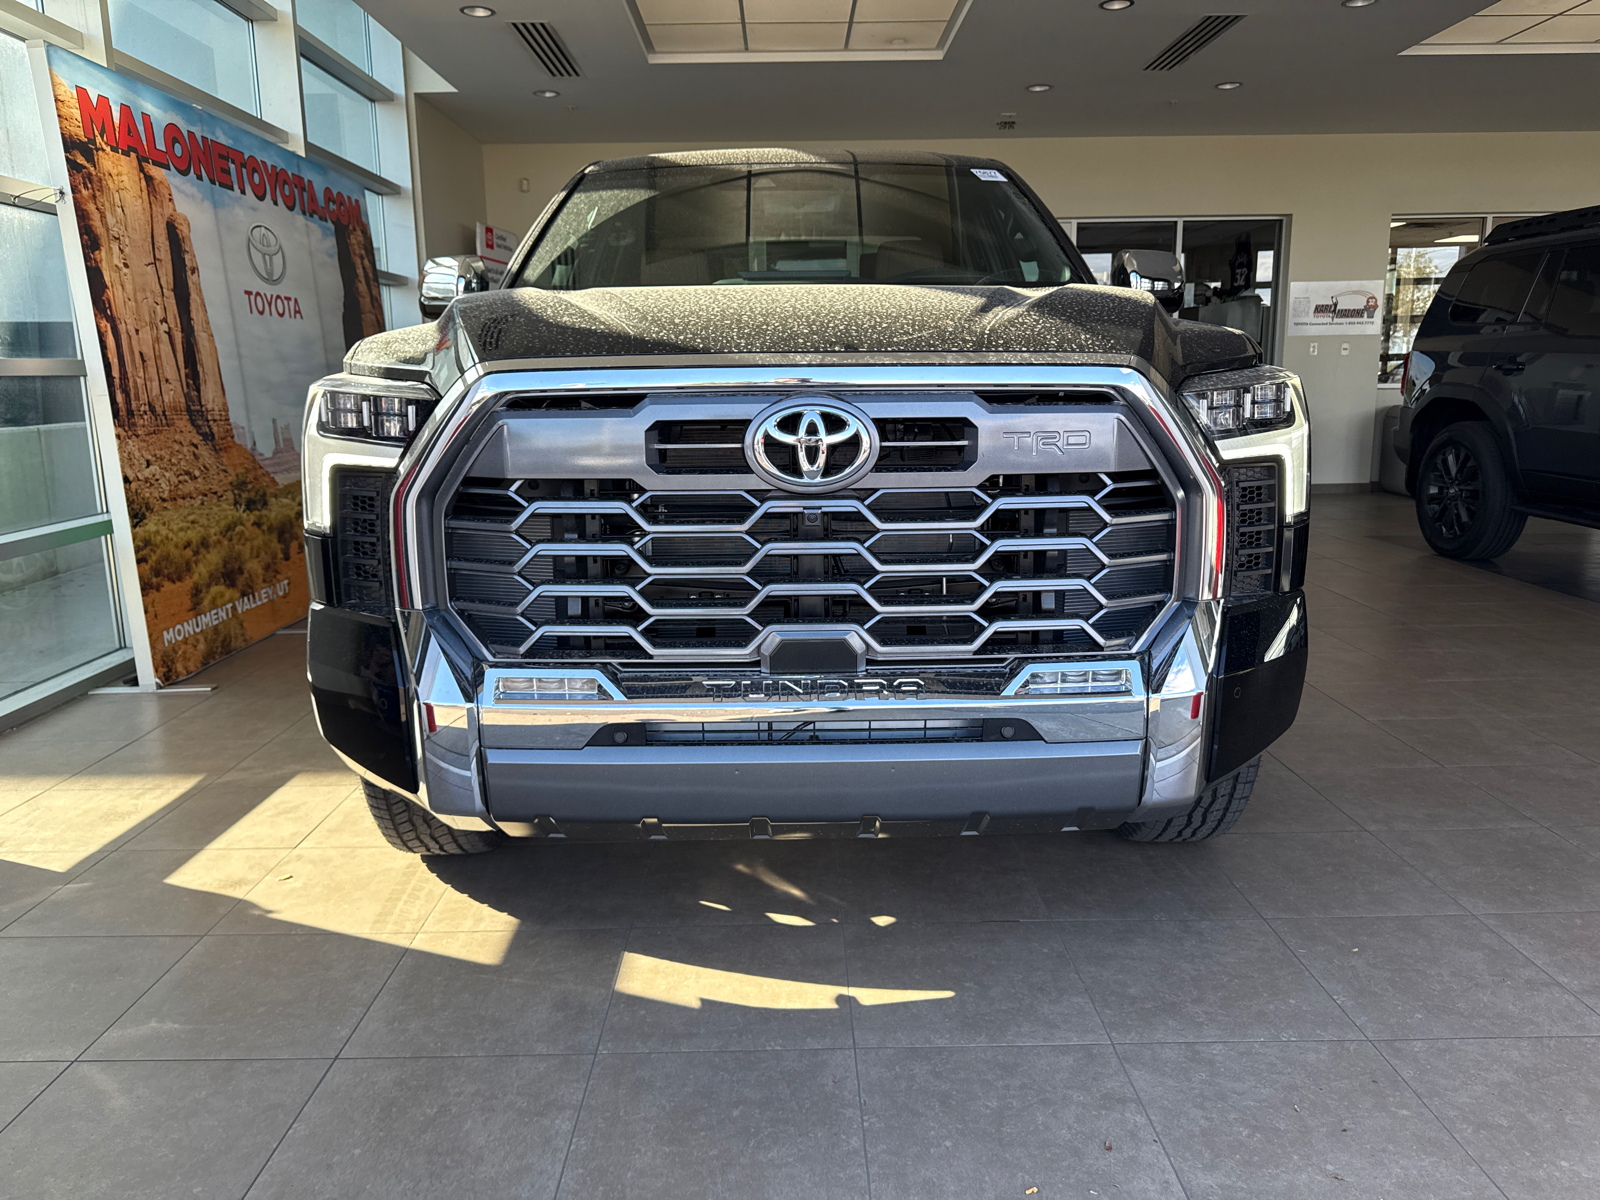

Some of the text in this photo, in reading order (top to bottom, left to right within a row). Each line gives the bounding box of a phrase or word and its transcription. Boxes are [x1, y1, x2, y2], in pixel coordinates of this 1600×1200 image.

[75, 85, 364, 225] MALONETOYOTA.COM
[1233, 267, 1248, 287] 32
[244, 289, 304, 320] TOYOTA
[1313, 304, 1334, 314] KARL
[1335, 308, 1366, 319] MALONE
[1002, 429, 1092, 456] TRD
[162, 602, 234, 647] MONUMENT
[276, 579, 290, 596] UT
[701, 678, 926, 702] TUNDRA
